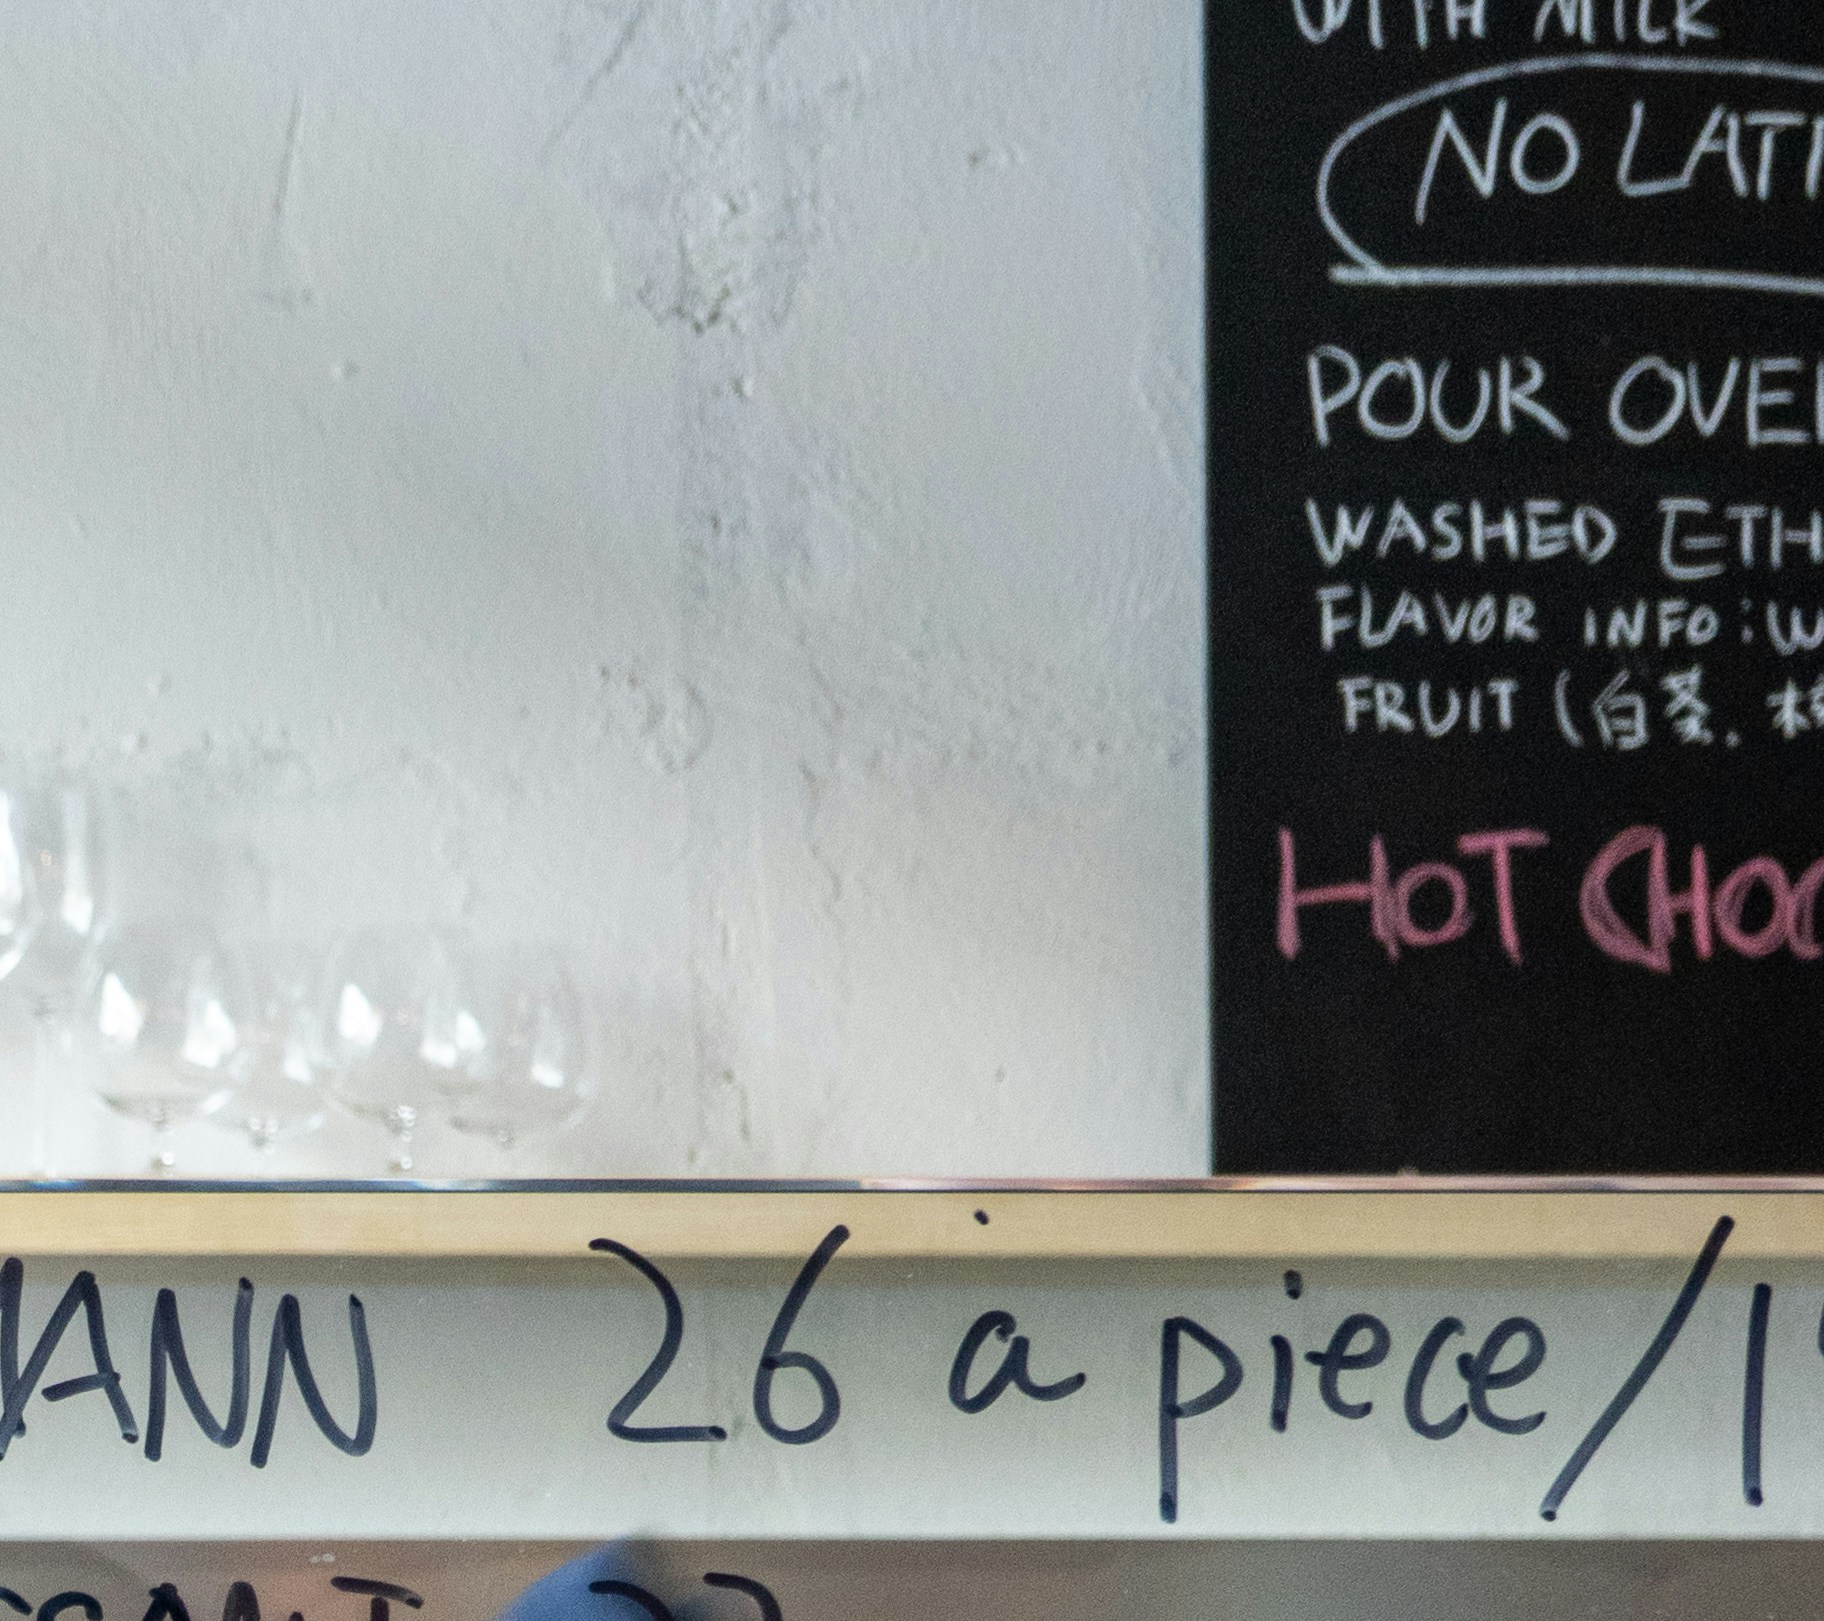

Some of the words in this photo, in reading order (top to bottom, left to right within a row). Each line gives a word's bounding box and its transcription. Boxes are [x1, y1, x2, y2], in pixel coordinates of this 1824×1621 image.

[1415, 98, 1580, 226] NO
[1307, 344, 1569, 447] POUR
[1608, 355, 1824, 446] OVE
[1305, 497, 1617, 567] WASHED
[1317, 584, 1539, 651] FLAVOR
[1337, 678, 1518, 738] FRUIT
[1276, 825, 1549, 965] HOT
[588, 1224, 850, 1445] 26
